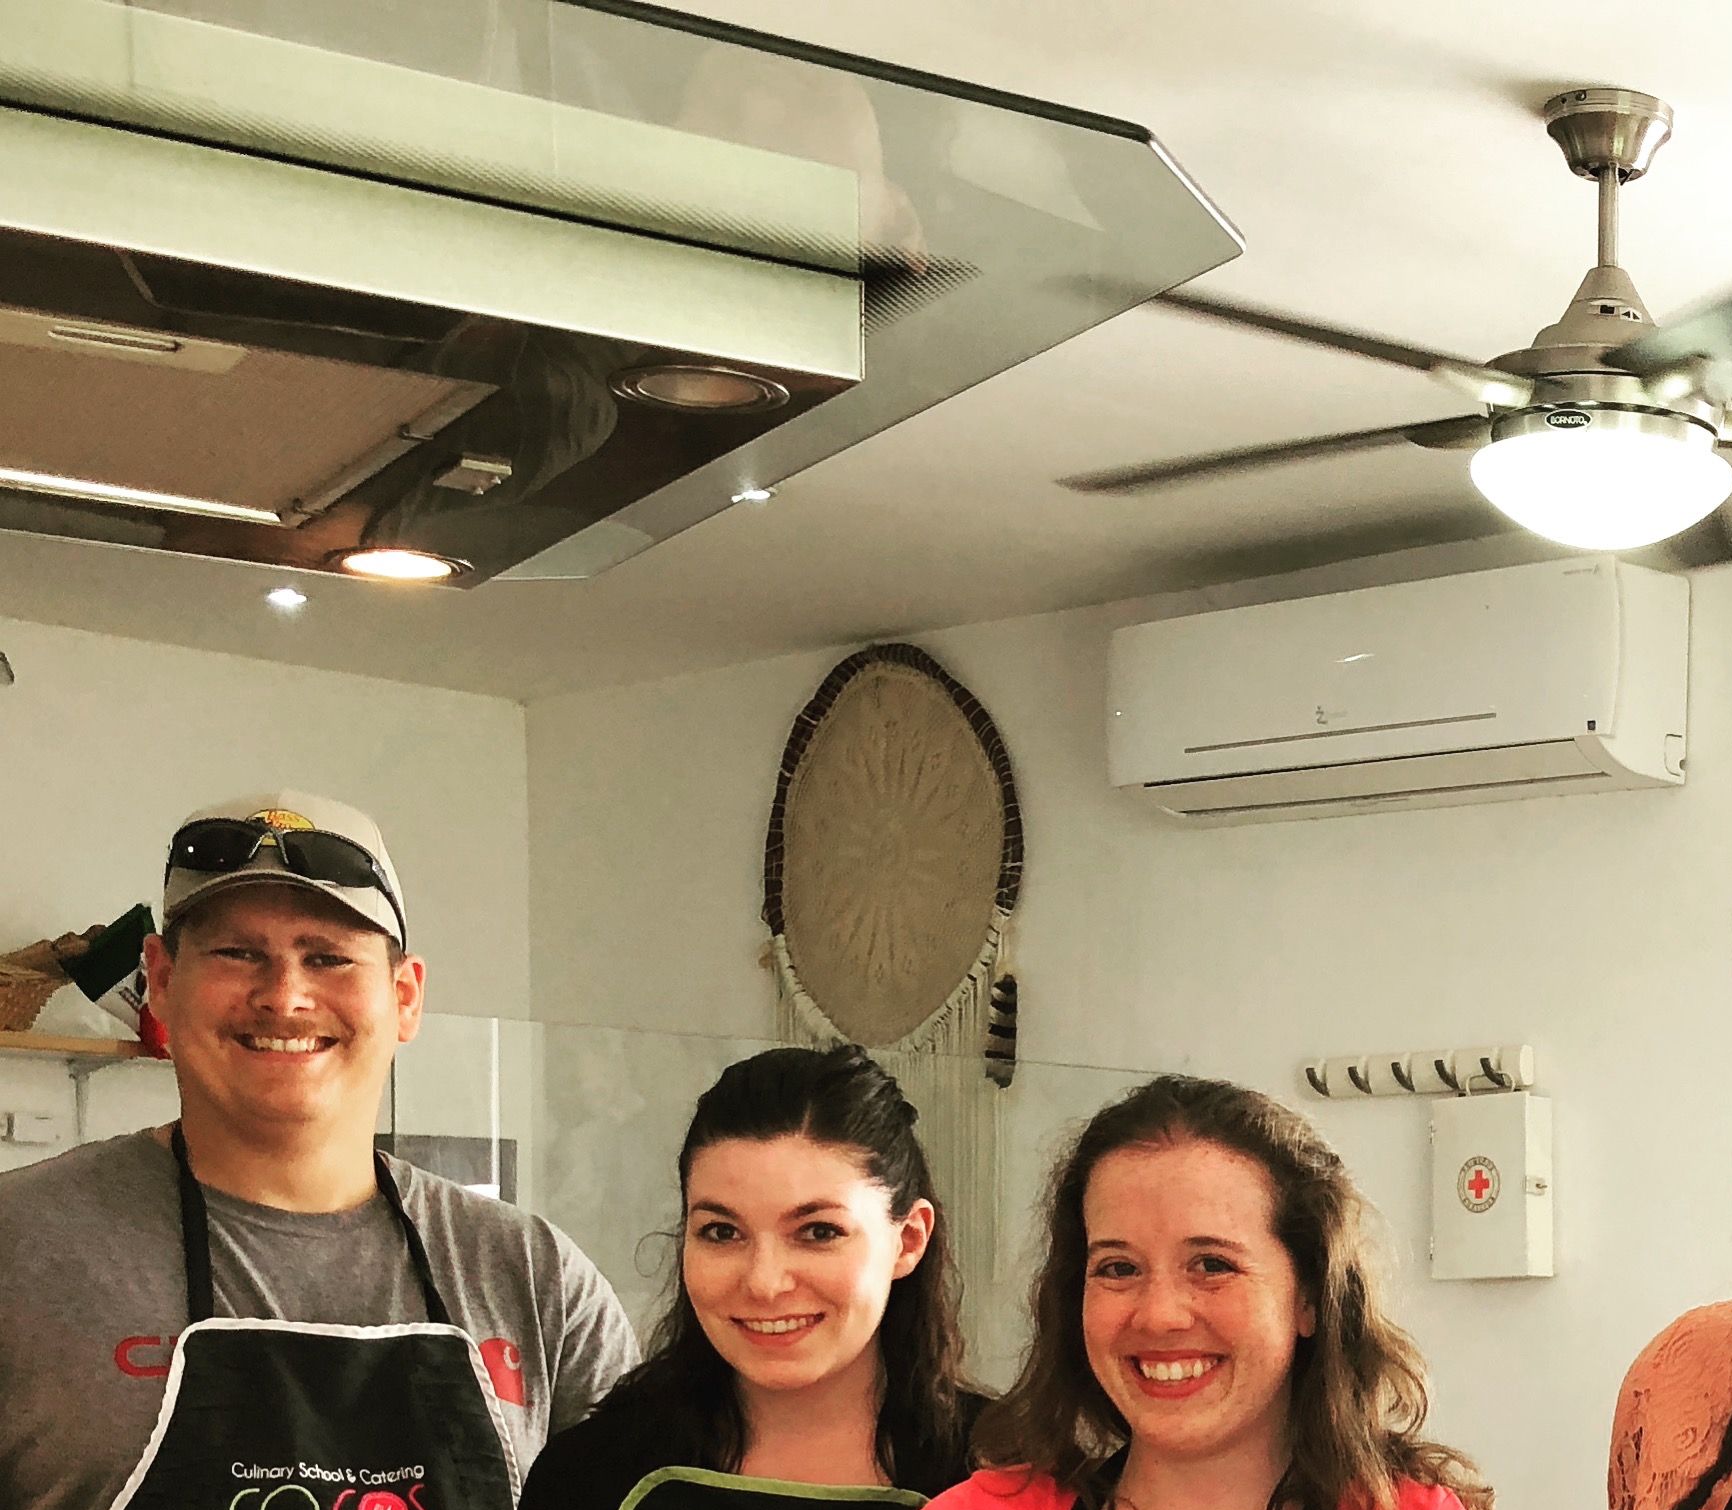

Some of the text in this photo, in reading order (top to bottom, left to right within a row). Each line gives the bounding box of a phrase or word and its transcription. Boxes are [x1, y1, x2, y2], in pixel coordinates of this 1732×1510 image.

[231, 1461, 425, 1485] Culinary School & Catering
